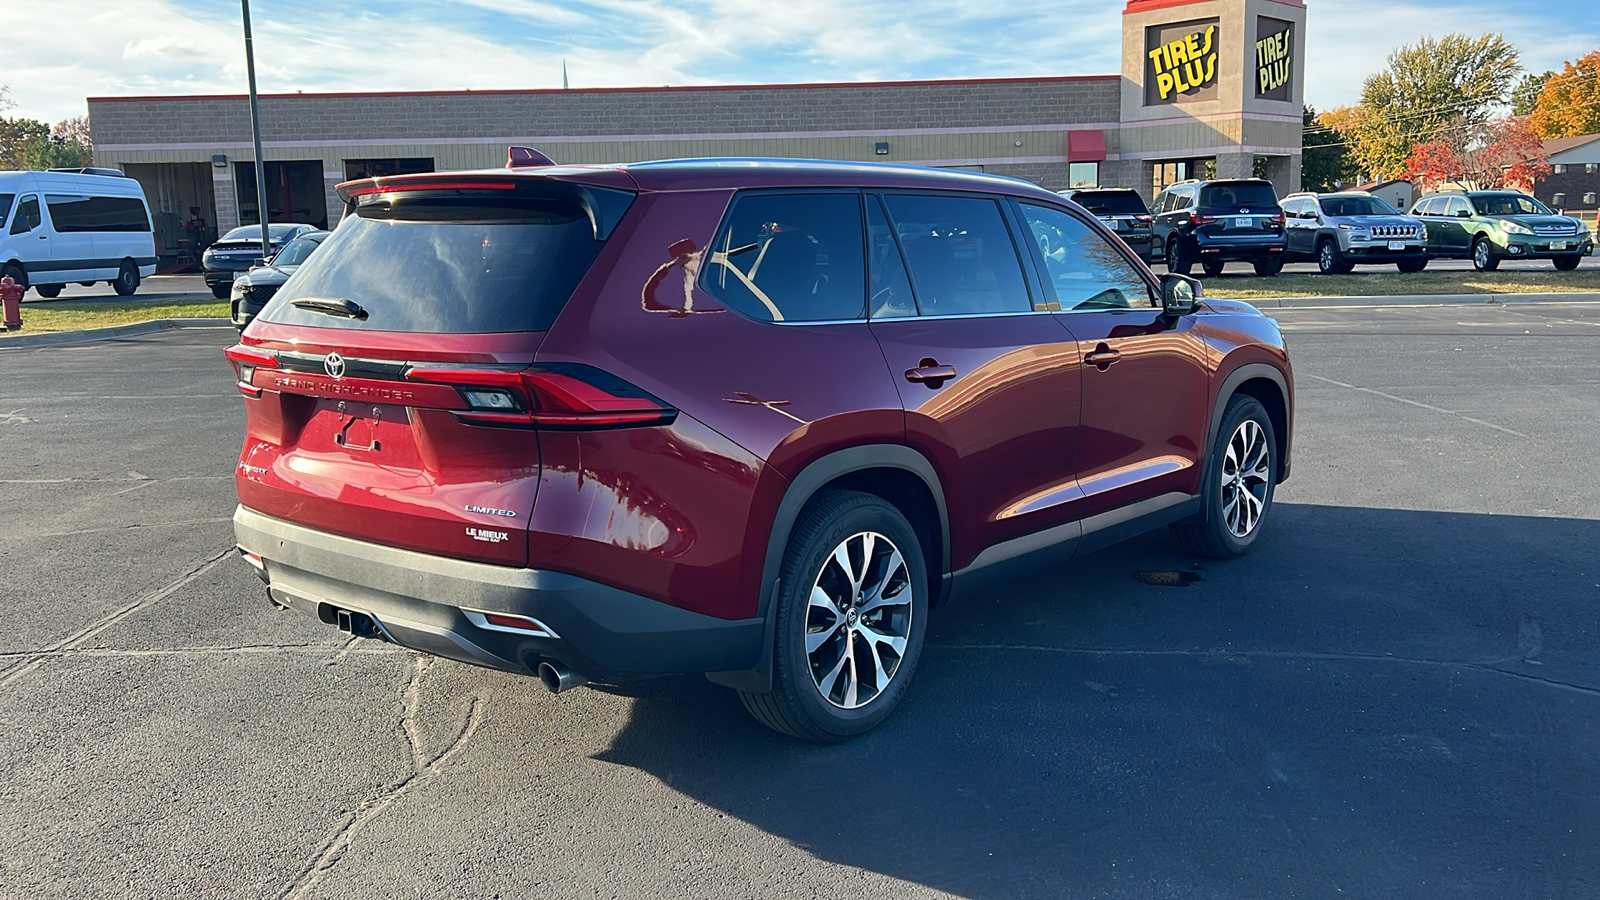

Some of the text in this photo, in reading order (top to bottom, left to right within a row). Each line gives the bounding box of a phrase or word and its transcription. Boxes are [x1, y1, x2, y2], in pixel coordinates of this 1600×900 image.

[1149, 25, 1215, 74] TIRES
[1256, 29, 1290, 67] TIRES
[1157, 52, 1217, 99] PLUS
[1259, 56, 1290, 94] PLUS
[275, 378, 413, 399] GRAND HIGHLANDER
[465, 505, 517, 517] LIMITED
[466, 527, 508, 540] LE MIEUX
